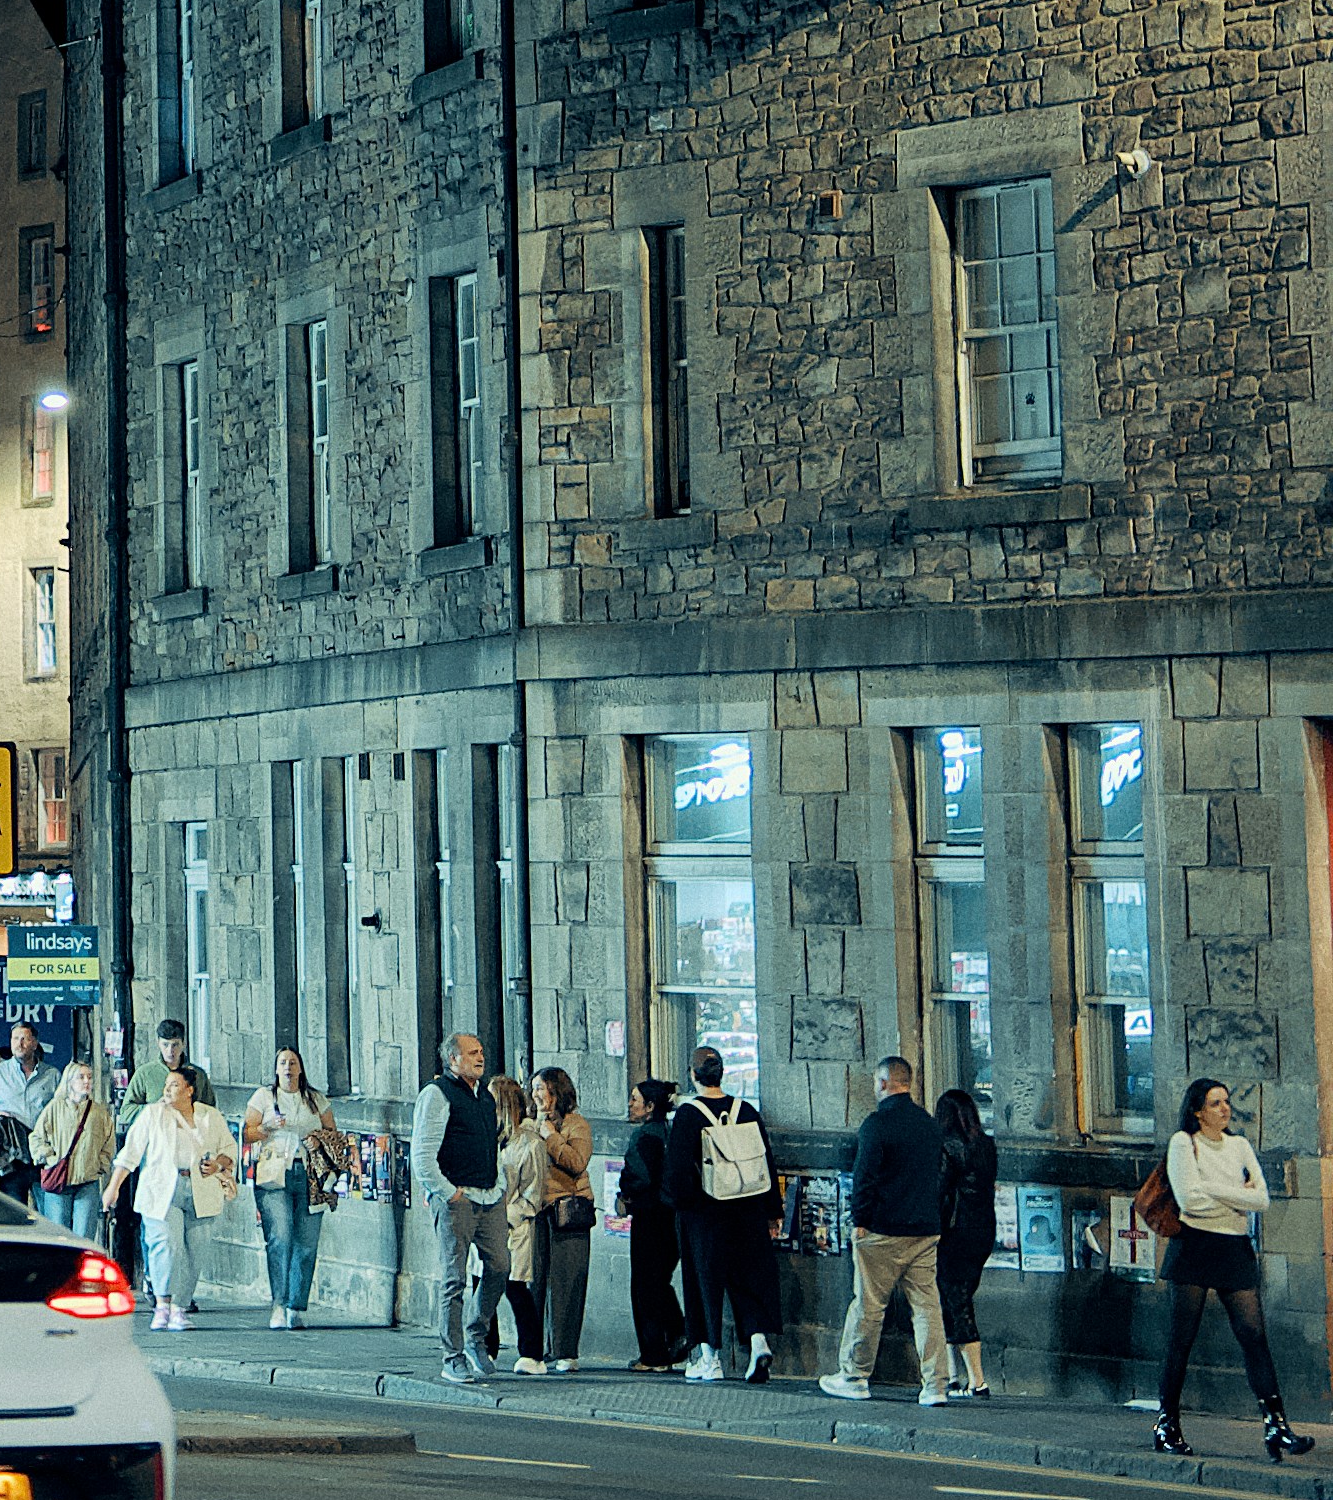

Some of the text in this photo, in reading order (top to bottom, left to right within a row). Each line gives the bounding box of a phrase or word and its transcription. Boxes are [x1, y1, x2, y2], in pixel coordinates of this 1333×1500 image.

[26, 932, 93, 953] lindsays
[29, 963, 87, 975] FOR SALE
[6, 997, 56, 1024] DRY
